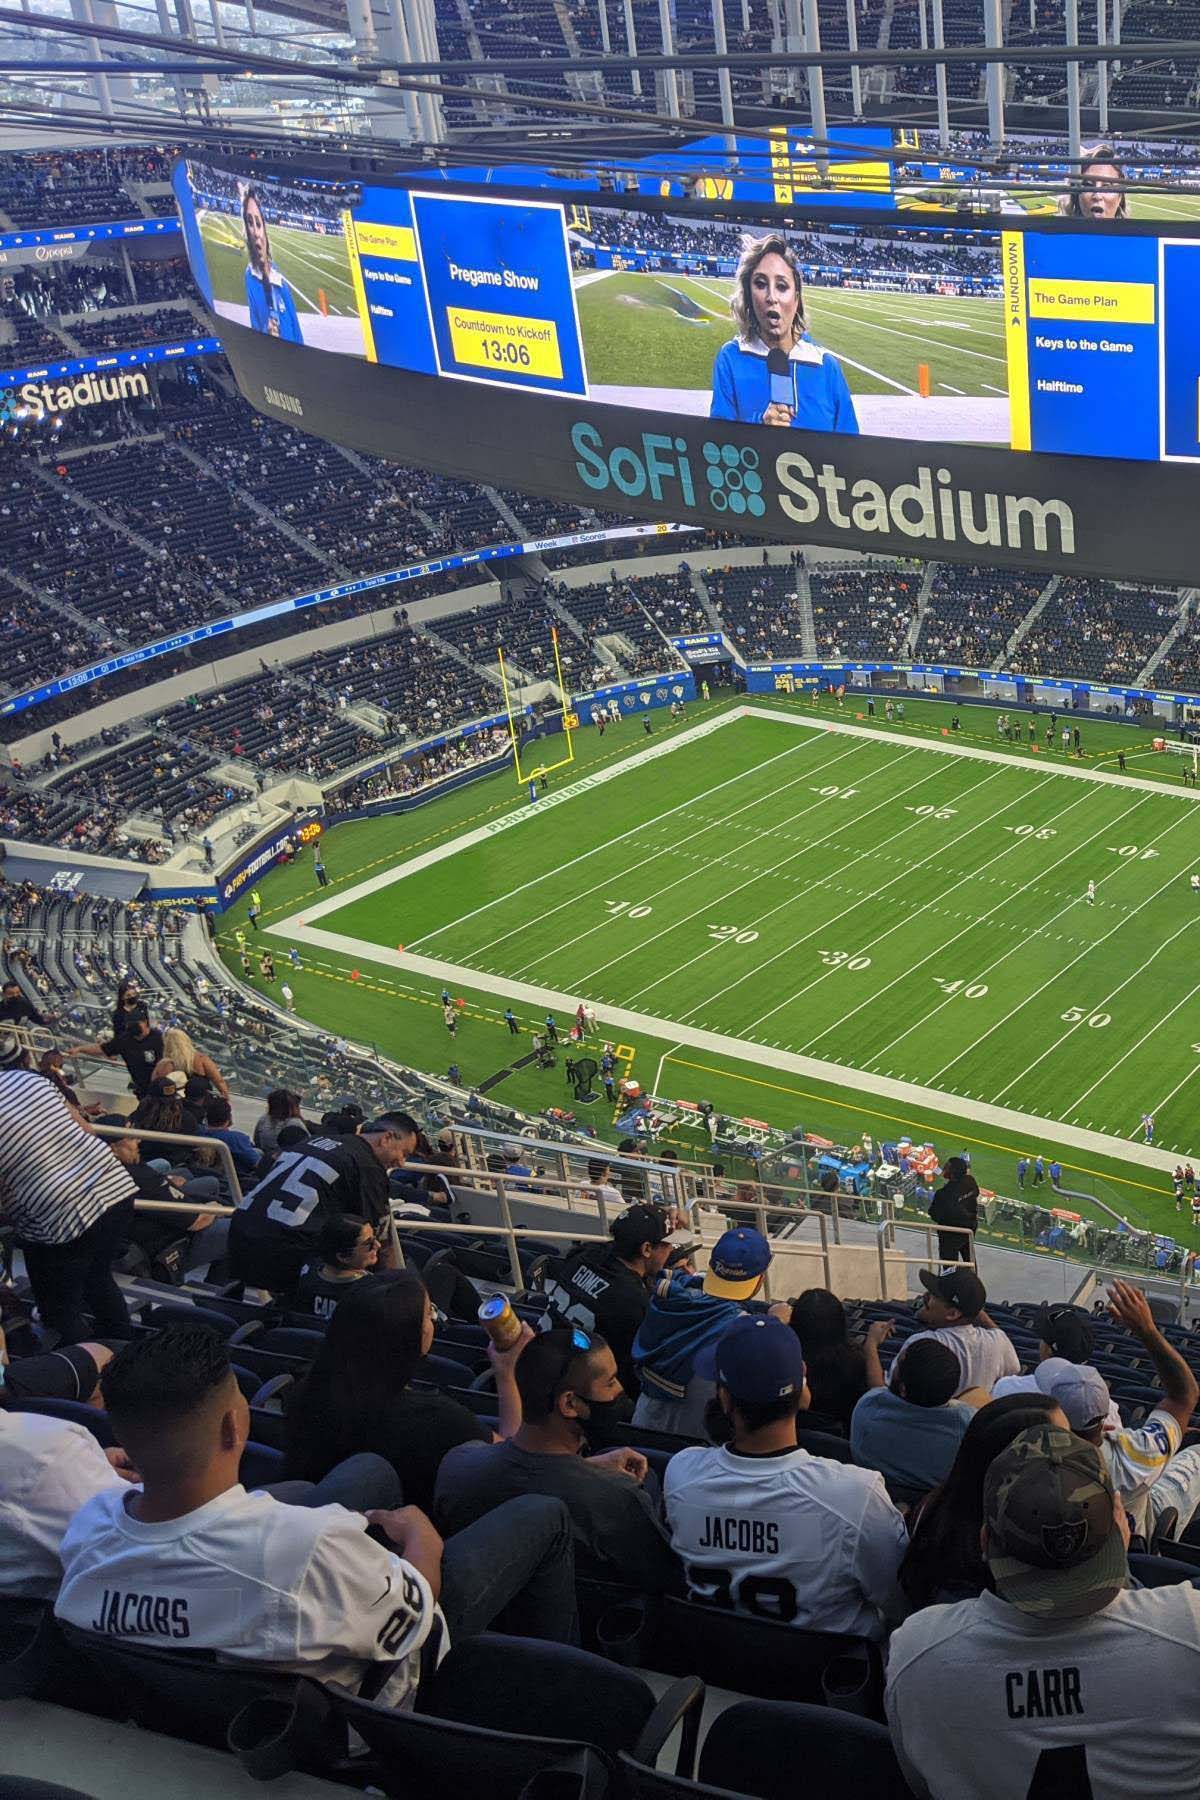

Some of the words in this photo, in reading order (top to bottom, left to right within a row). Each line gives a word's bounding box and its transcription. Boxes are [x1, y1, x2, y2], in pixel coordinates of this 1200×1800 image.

[450, 264, 502, 288] Pregame
[503, 270, 539, 290] Show
[1008, 242, 1020, 313] RUNDOWN
[1034, 292, 1055, 304] The
[1058, 294, 1091, 306] Game
[1093, 296, 1118, 307] Plan
[454, 316, 504, 335] Countdown
[506, 324, 515, 336] to
[518, 326, 551, 341] Kickoff
[482, 339, 530, 366] 13:06
[1035, 336, 1064, 351] Keys
[1066, 339, 1078, 350] to
[1079, 339, 1098, 351] the
[1100, 340, 1134, 353] Game
[21, 373, 149, 411] Stadium
[1037, 379, 1084, 394] Halftime
[264, 385, 303, 416] SAMSUNG
[570, 422, 696, 507] SoFi
[776, 451, 1077, 555] Stadium
[657, 524, 668, 533] 20
[534, 540, 558, 550] Week
[579, 532, 607, 543] Scores
[532, 777, 601, 811] FOOTBALL
[819, 785, 861, 800] 10
[916, 804, 959, 820] 20
[1013, 824, 1057, 841] 30
[1118, 845, 1161, 861] 40
[605, 901, 653, 919] 10
[709, 926, 760, 944] 20
[821, 952, 872, 971] 30
[940, 979, 989, 999] 40
[1060, 1006, 1112, 1029] 50
[237, 1152, 340, 1227] 75
[571, 1264, 611, 1300] GOMEZ
[700, 1516, 780, 1556] JACOBS
[92, 1589, 191, 1639] JACOBS
[1005, 1666, 1084, 1720] CARR
